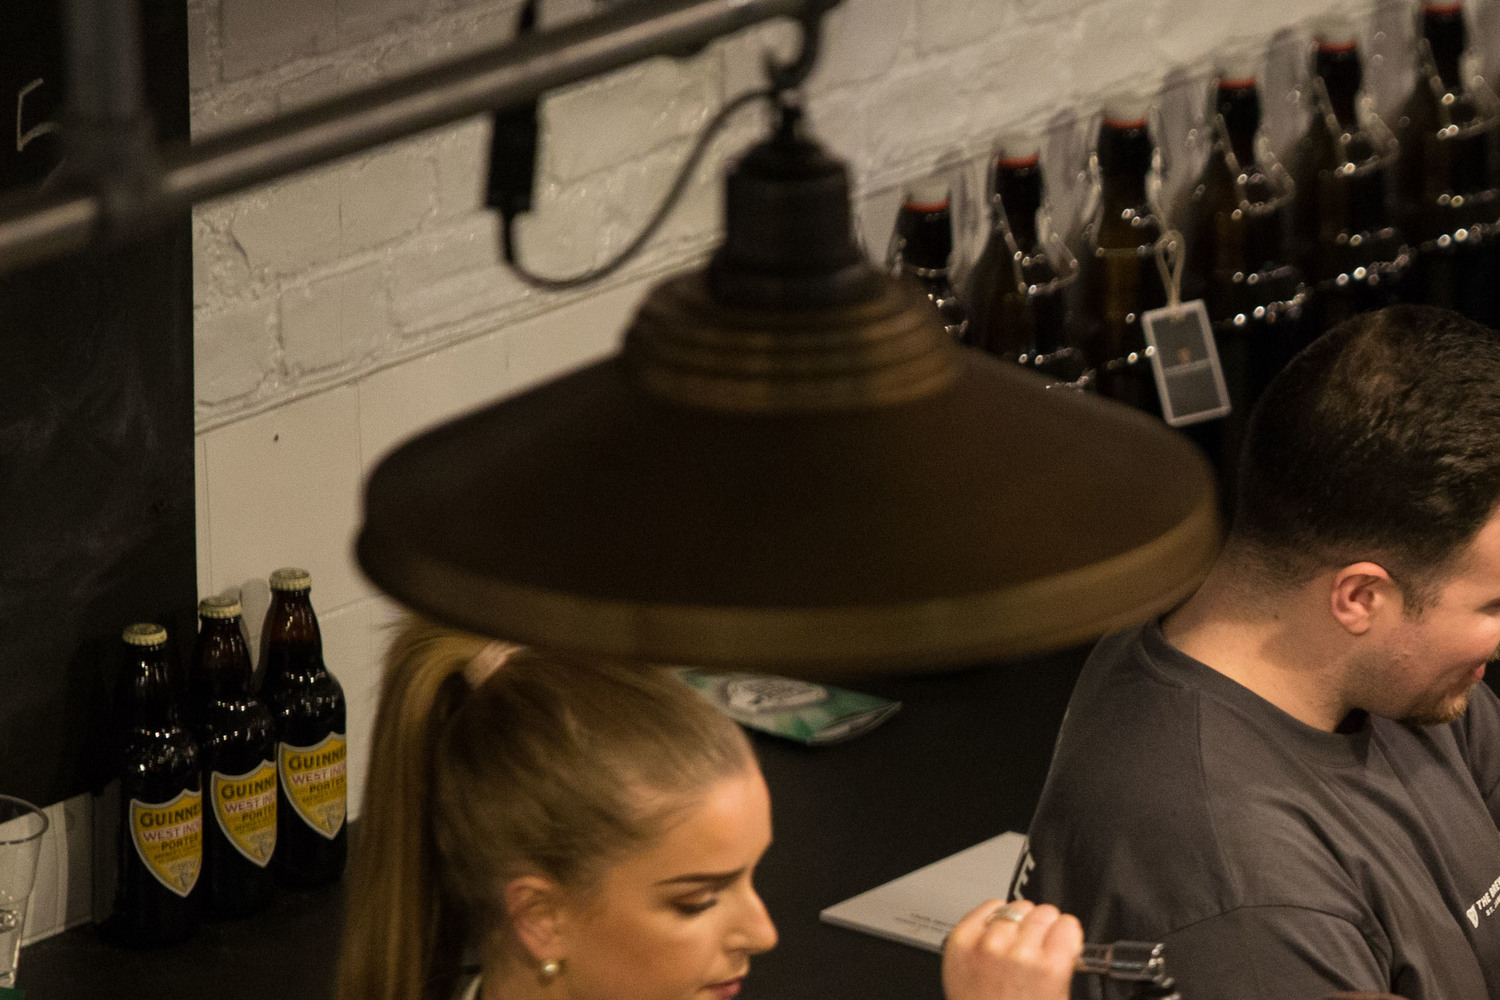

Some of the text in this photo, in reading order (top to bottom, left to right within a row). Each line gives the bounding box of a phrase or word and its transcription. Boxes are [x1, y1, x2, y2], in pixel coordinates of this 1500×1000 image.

[291, 770, 327, 785] WEST
[224, 800, 260, 814] WEST
[143, 826, 180, 842] WEST
[1476, 892, 1492, 911] THE
